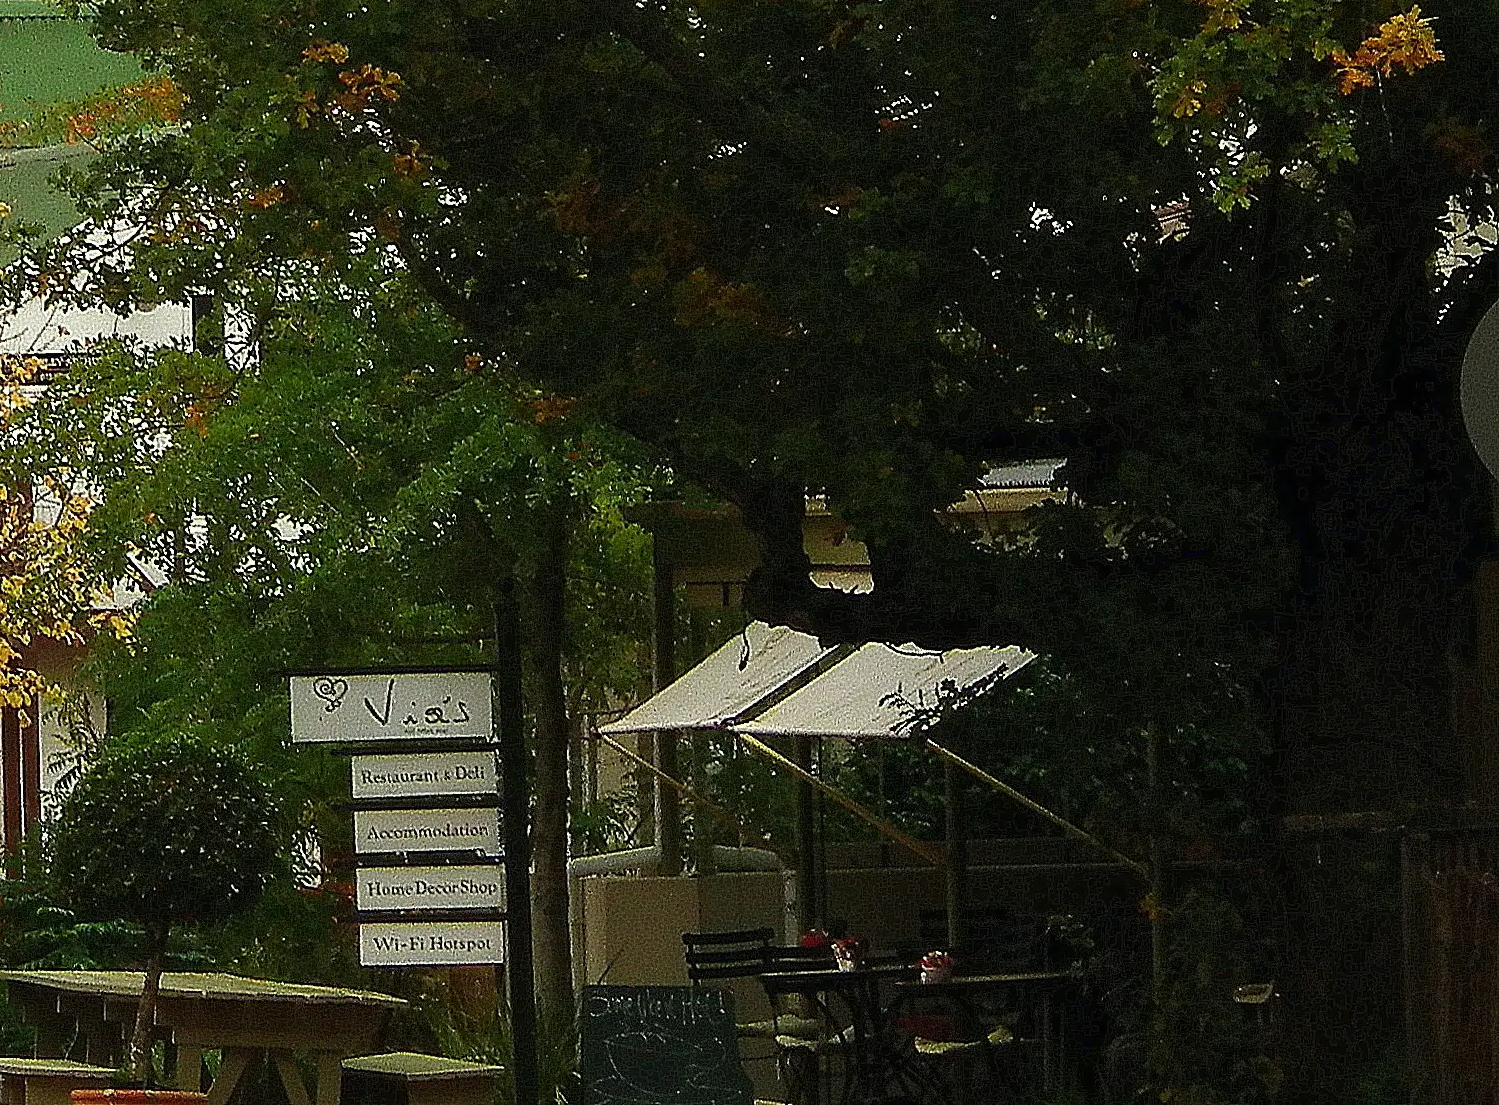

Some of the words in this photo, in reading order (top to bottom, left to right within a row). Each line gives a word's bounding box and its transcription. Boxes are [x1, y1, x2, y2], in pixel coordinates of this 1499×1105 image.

[361, 769, 439, 785] Restaurant
[454, 765, 485, 781] Deli
[367, 822, 489, 840] Accommodation
[367, 881, 413, 897] Home
[460, 879, 497, 896] Shop
[372, 936, 425, 952] Wi-Fi
[429, 936, 492, 952] Hotspot
